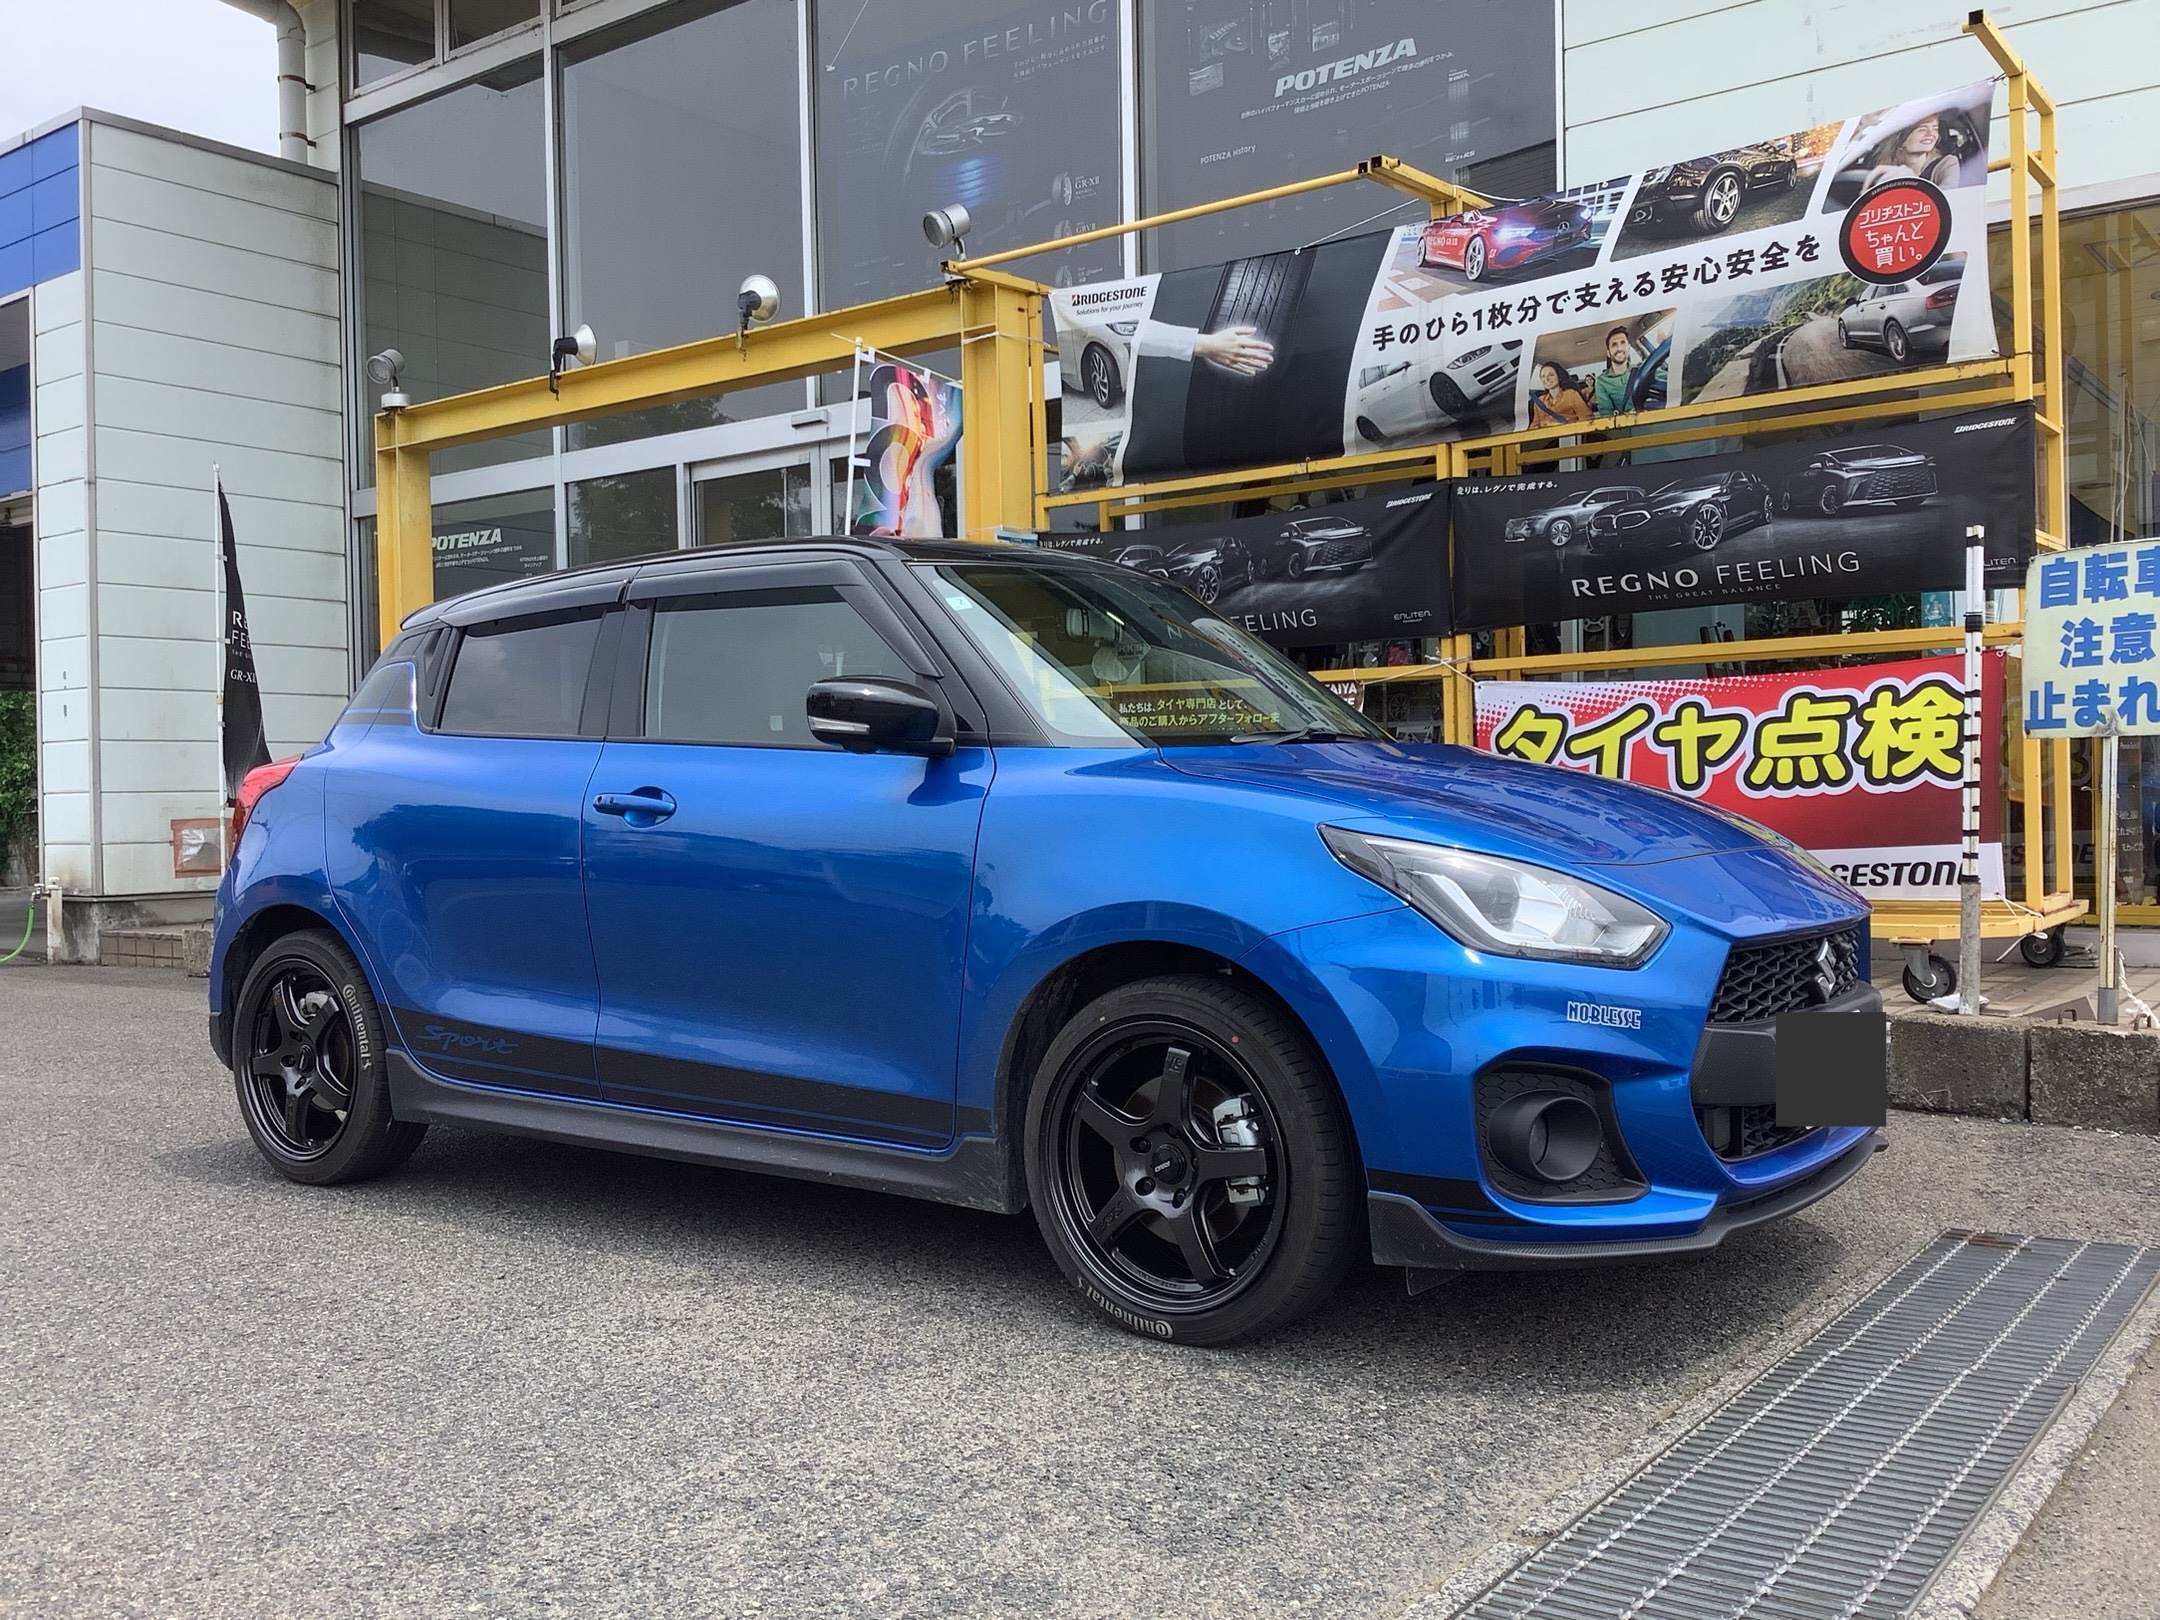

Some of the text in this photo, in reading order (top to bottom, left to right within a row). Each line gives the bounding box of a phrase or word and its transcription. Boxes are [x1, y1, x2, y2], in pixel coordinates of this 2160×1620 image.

[844, 0, 1107, 100] REGNO FEELING
[1274, 37, 1418, 98] POTENZA
[1200, 150, 1232, 165] POTENZA
[1859, 201, 1931, 226] ブリヂストンの
[1865, 221, 1924, 248] ちゃんと
[1875, 246, 1922, 268] 買い。
[1071, 286, 1148, 307] BRIDGESTONE
[1372, 235, 1821, 352] 手のひら1枚分で支える安心安全を
[1076, 307, 1100, 316] Solutions
[1101, 305, 1109, 314] for
[1109, 304, 1122, 312] your
[1954, 417, 2017, 434] BRIDGESTONE
[1572, 551, 1860, 598] REGNO FEELING
[1676, 589, 1714, 598] GREAT
[1722, 583, 1781, 594] BALANCE
[1230, 608, 1318, 634] ELING
[2060, 612, 2157, 668] 注意
[1325, 682, 1358, 695] AIYA
[2024, 676, 2160, 729] 止まれ
[1495, 680, 1966, 790] タイヤ点検
[343, 984, 372, 1058] Continental
[1567, 1001, 1642, 1029] NOBLESSE
[1086, 1284, 1174, 1339] Continental
